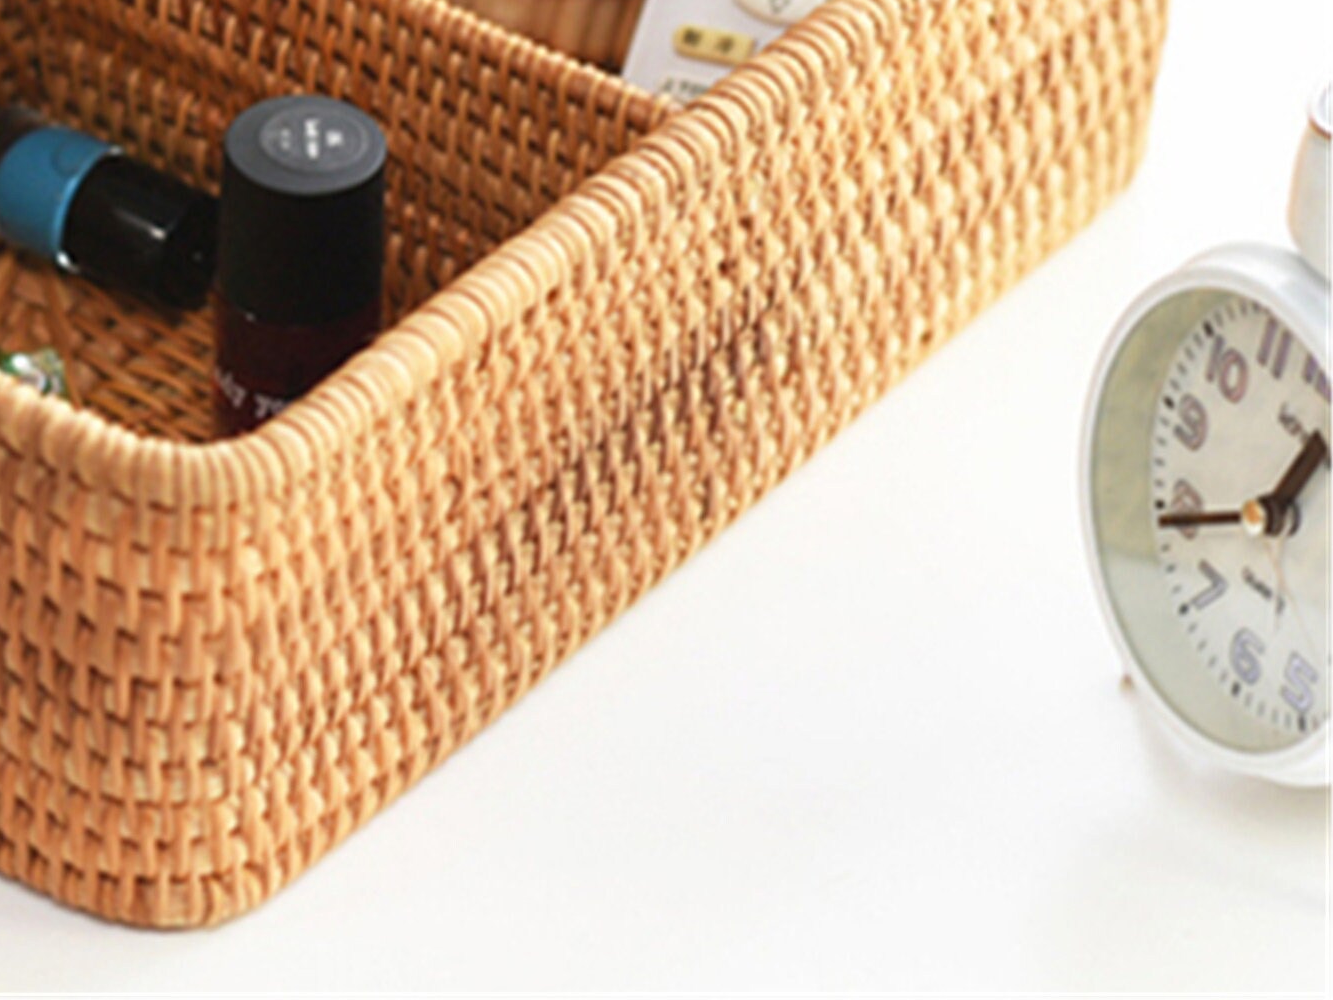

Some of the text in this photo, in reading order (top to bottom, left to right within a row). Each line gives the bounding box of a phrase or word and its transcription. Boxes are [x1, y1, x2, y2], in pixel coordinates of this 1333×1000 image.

[1206, 334, 1249, 403] 10
[1174, 394, 1208, 451] 9
[1190, 558, 1229, 610] 7
[1229, 628, 1266, 685] 6
[1280, 651, 1320, 713] 5
